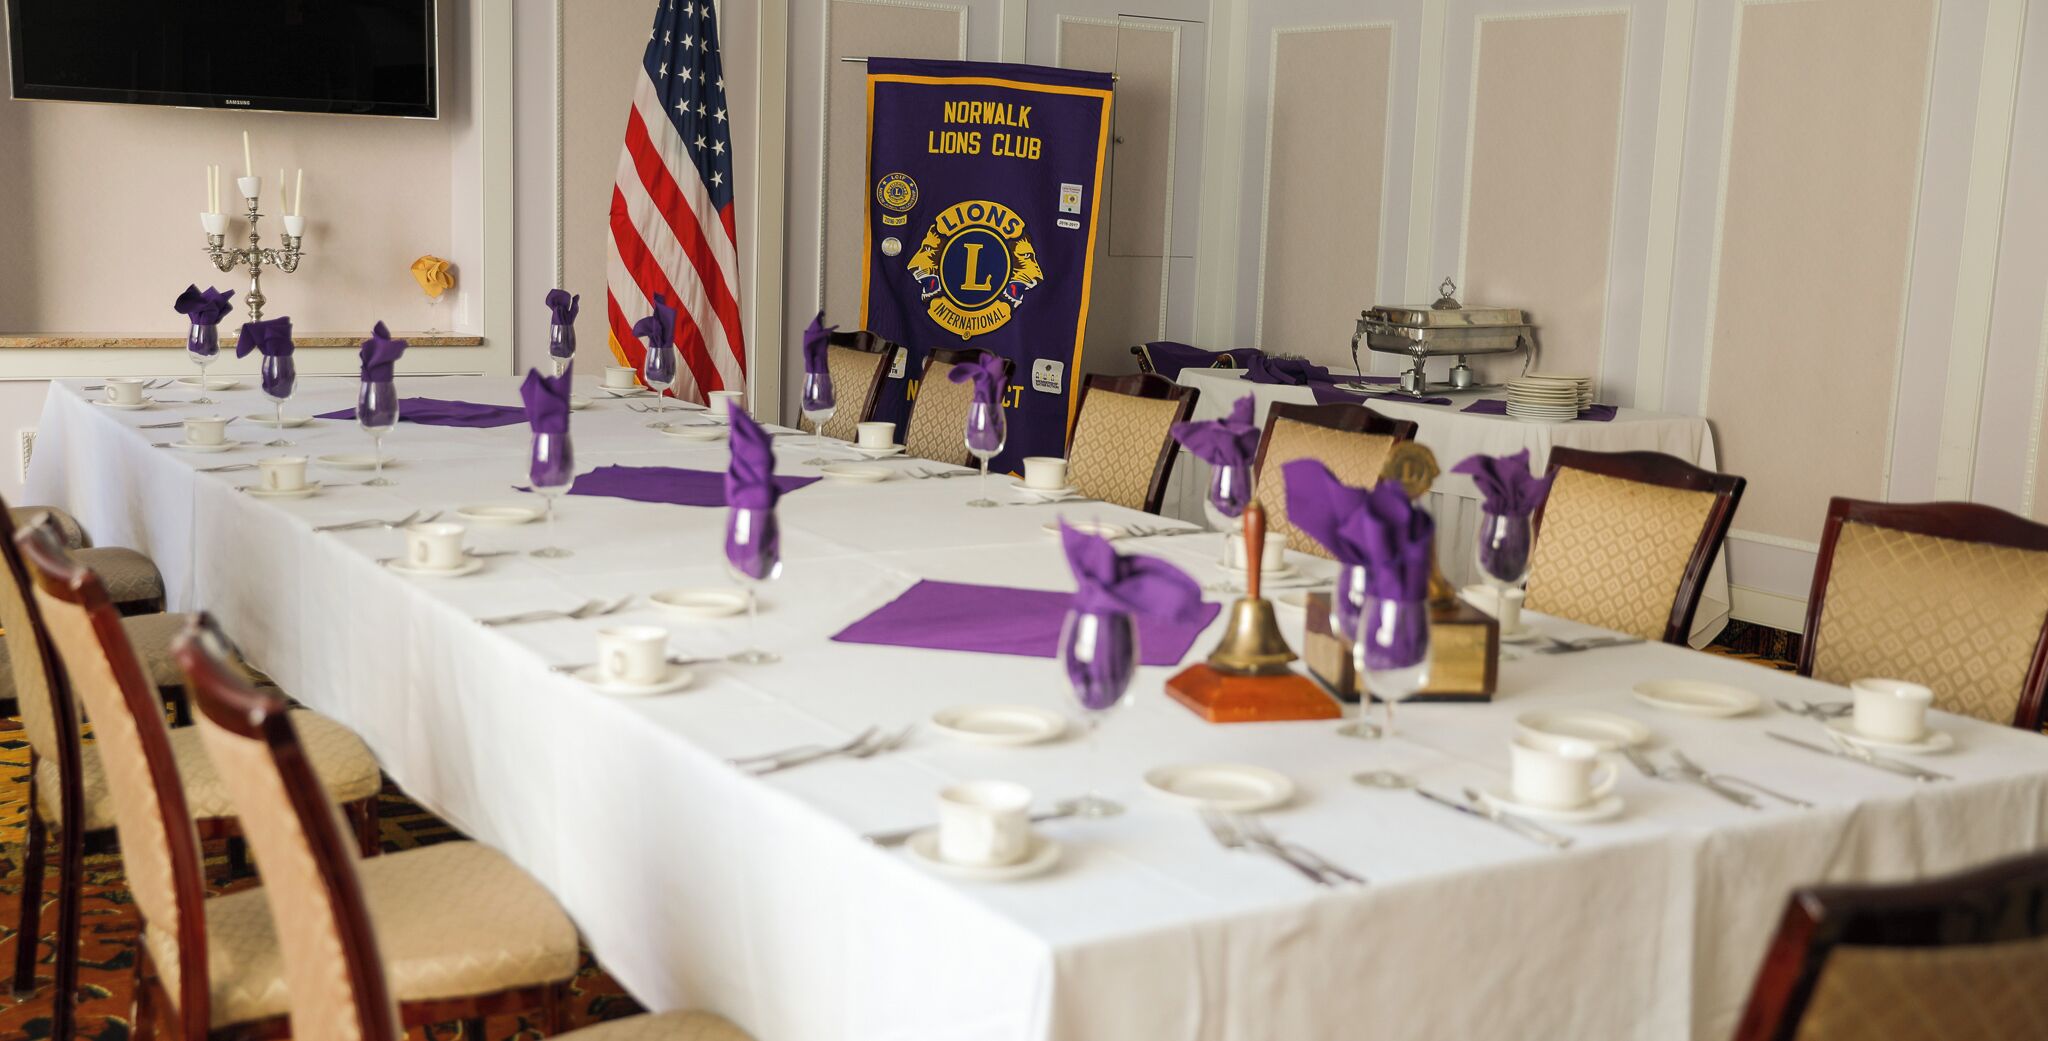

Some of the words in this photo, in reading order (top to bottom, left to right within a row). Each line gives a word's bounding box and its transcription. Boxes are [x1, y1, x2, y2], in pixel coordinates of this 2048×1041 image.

[944, 101, 1032, 128] NORWALK
[928, 130, 981, 155] LIONS
[992, 133, 1041, 160] CLUB
[941, 203, 1020, 235] LIONS
[961, 243, 992, 291] L
[933, 302, 1006, 331] INTERNATIONAL
